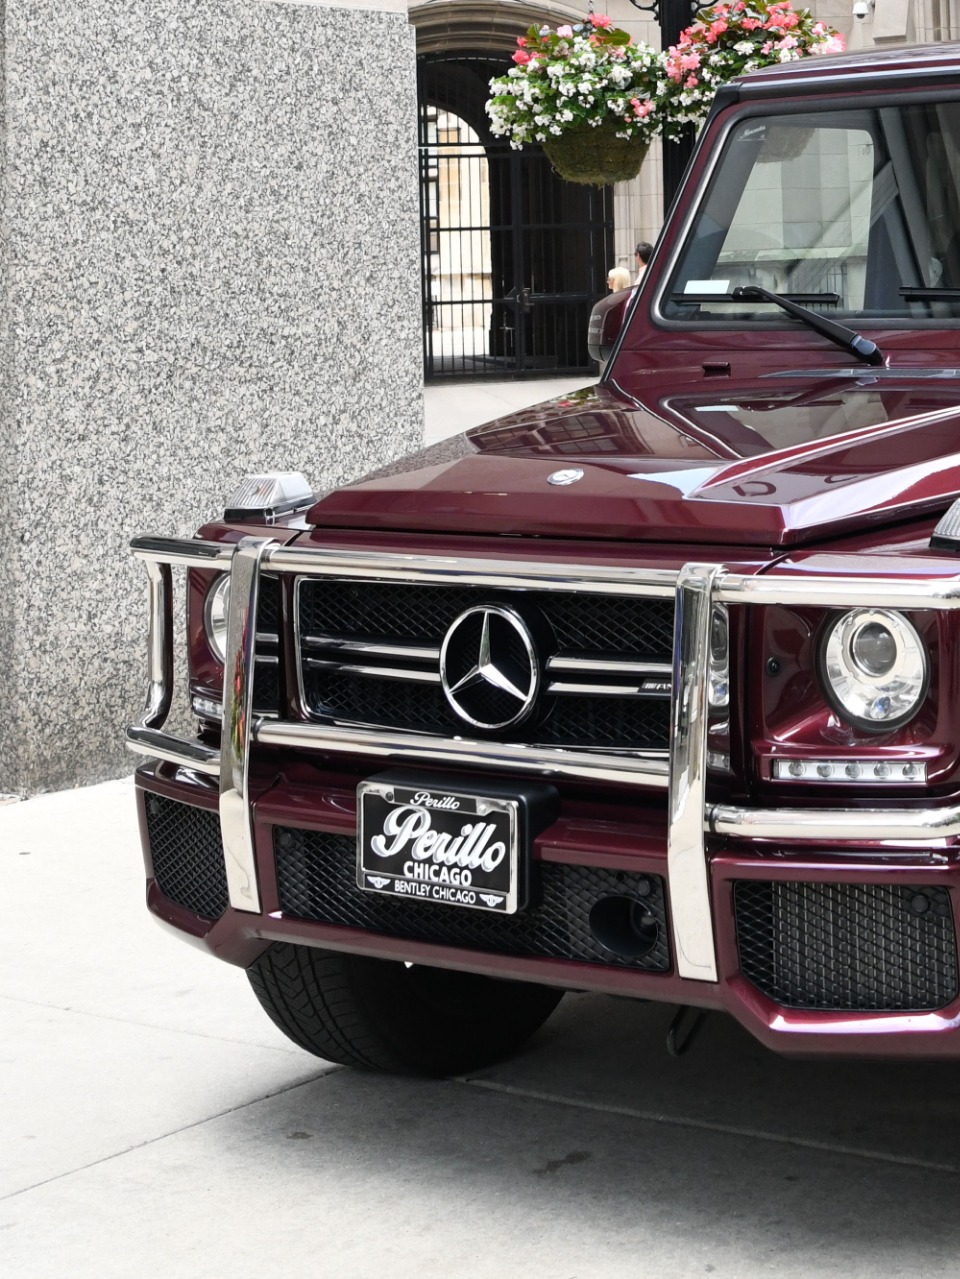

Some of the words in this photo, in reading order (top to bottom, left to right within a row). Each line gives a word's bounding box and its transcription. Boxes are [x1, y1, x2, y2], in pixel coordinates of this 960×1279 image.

[410, 791, 460, 810] Perillo
[371, 805, 506, 872] Perillo
[403, 861, 472, 886] CHICAGO
[394, 880, 431, 897] BENTLEY
[432, 886, 476, 905] CHICAGO
